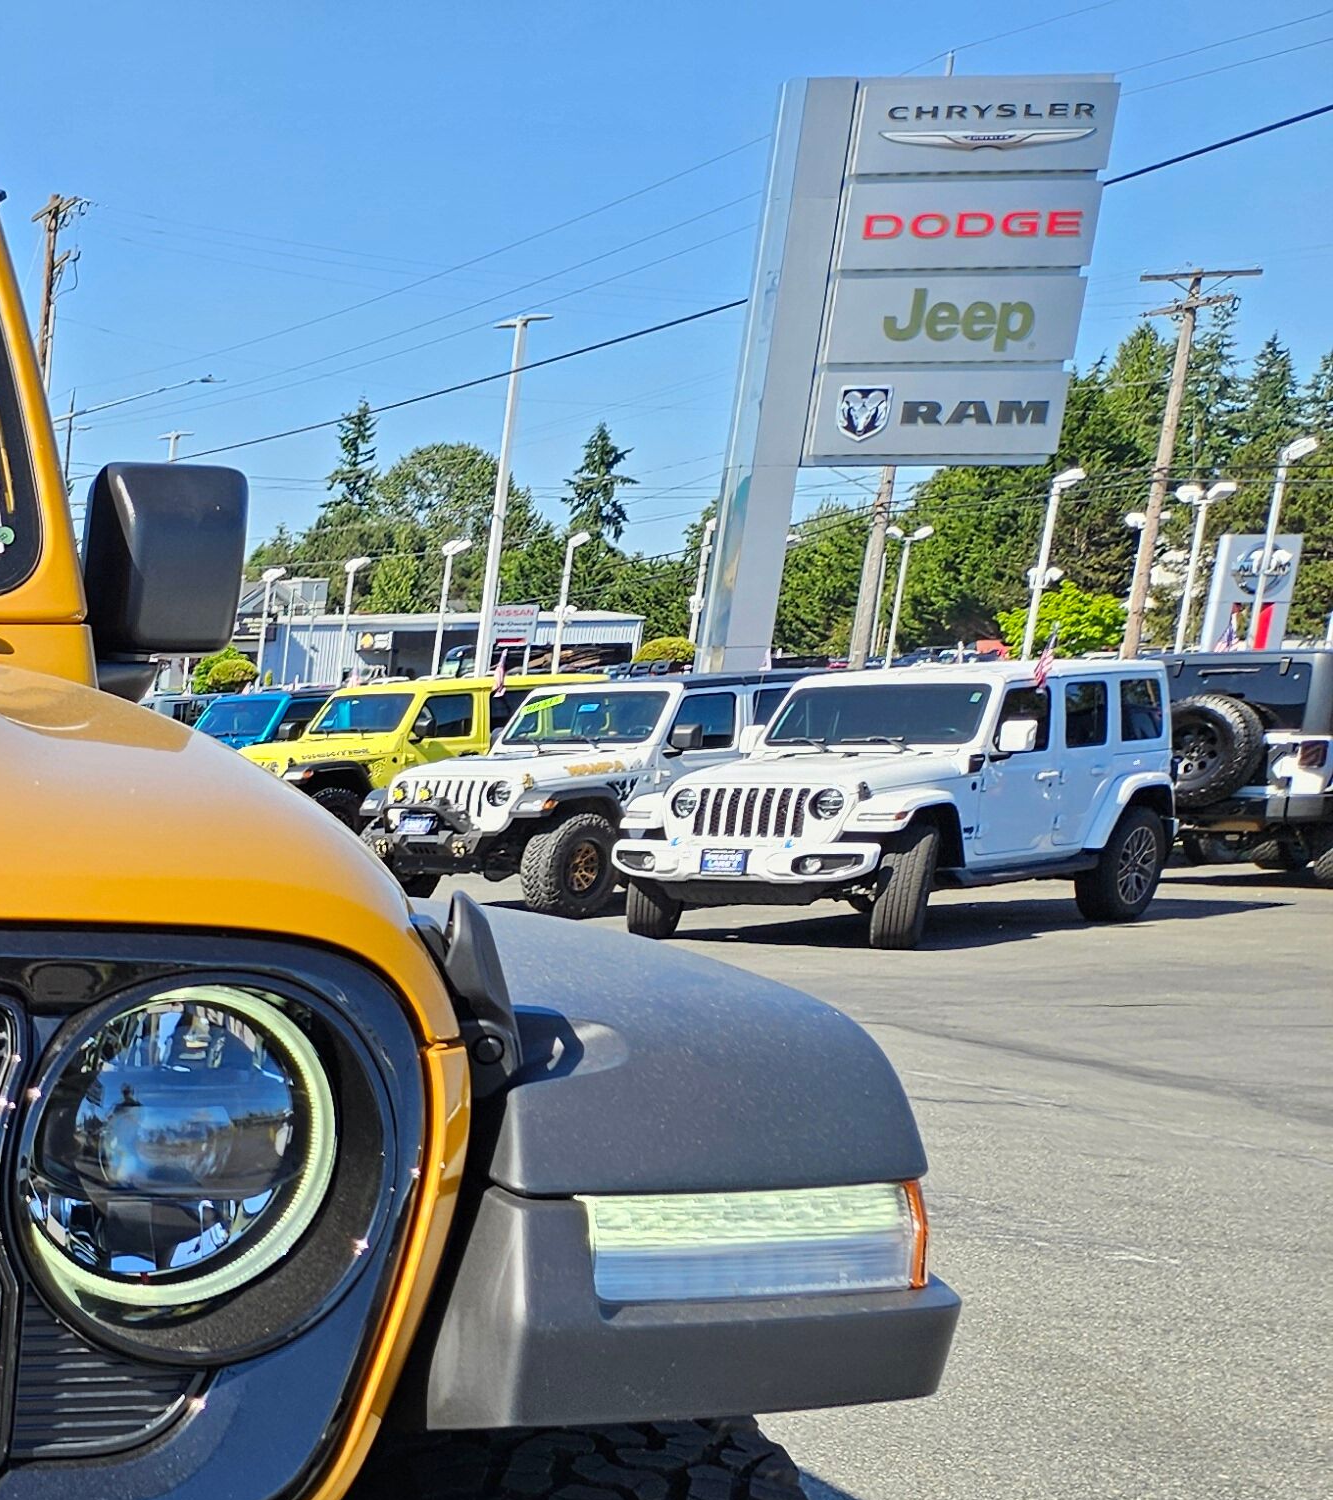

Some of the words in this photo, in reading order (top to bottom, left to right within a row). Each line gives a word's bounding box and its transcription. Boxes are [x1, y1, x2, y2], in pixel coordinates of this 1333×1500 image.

[888, 103, 1096, 120] CHRYSLER
[862, 211, 1084, 240] DODGE
[883, 288, 1034, 352] Jeep
[900, 400, 1050, 426] RAM
